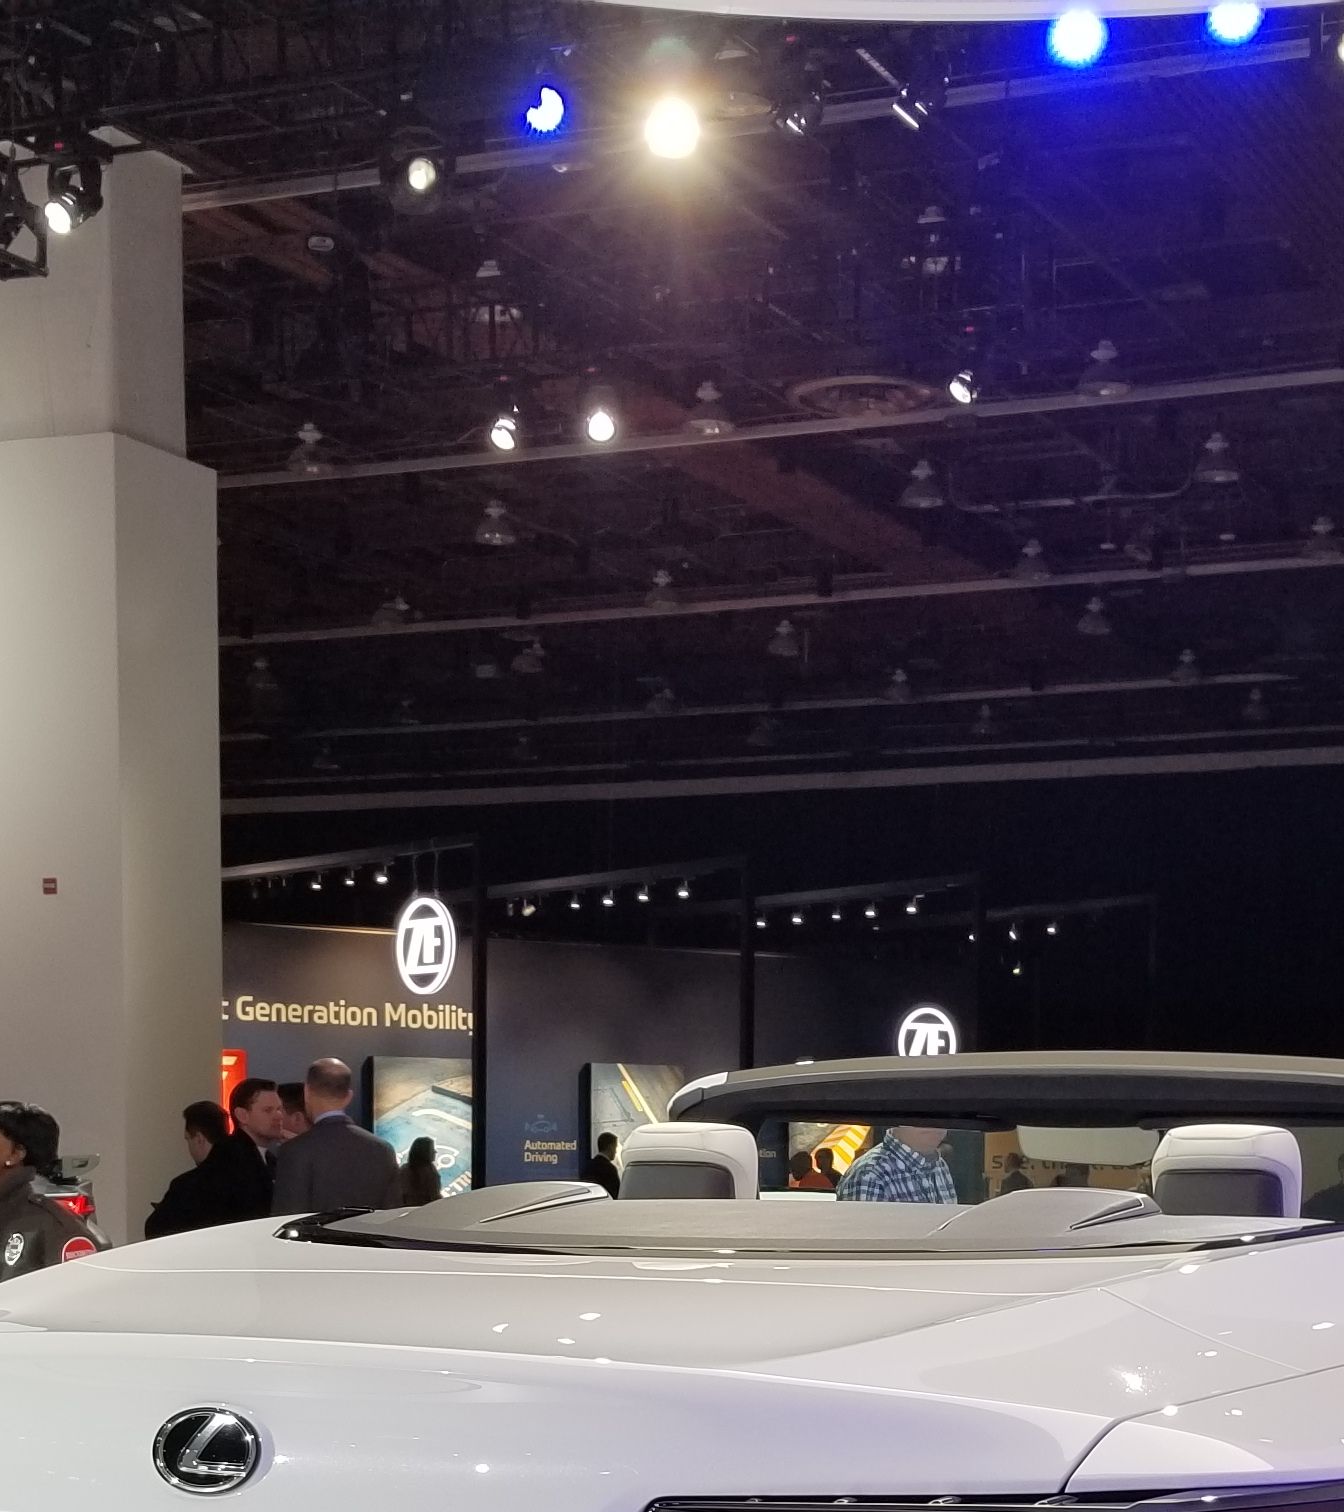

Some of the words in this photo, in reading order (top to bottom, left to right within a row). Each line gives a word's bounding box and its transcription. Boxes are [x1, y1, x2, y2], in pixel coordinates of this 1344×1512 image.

[235, 995, 378, 1027] Generation
[523, 1139, 577, 1151] Automated
[523, 1151, 558, 1165] Driving
